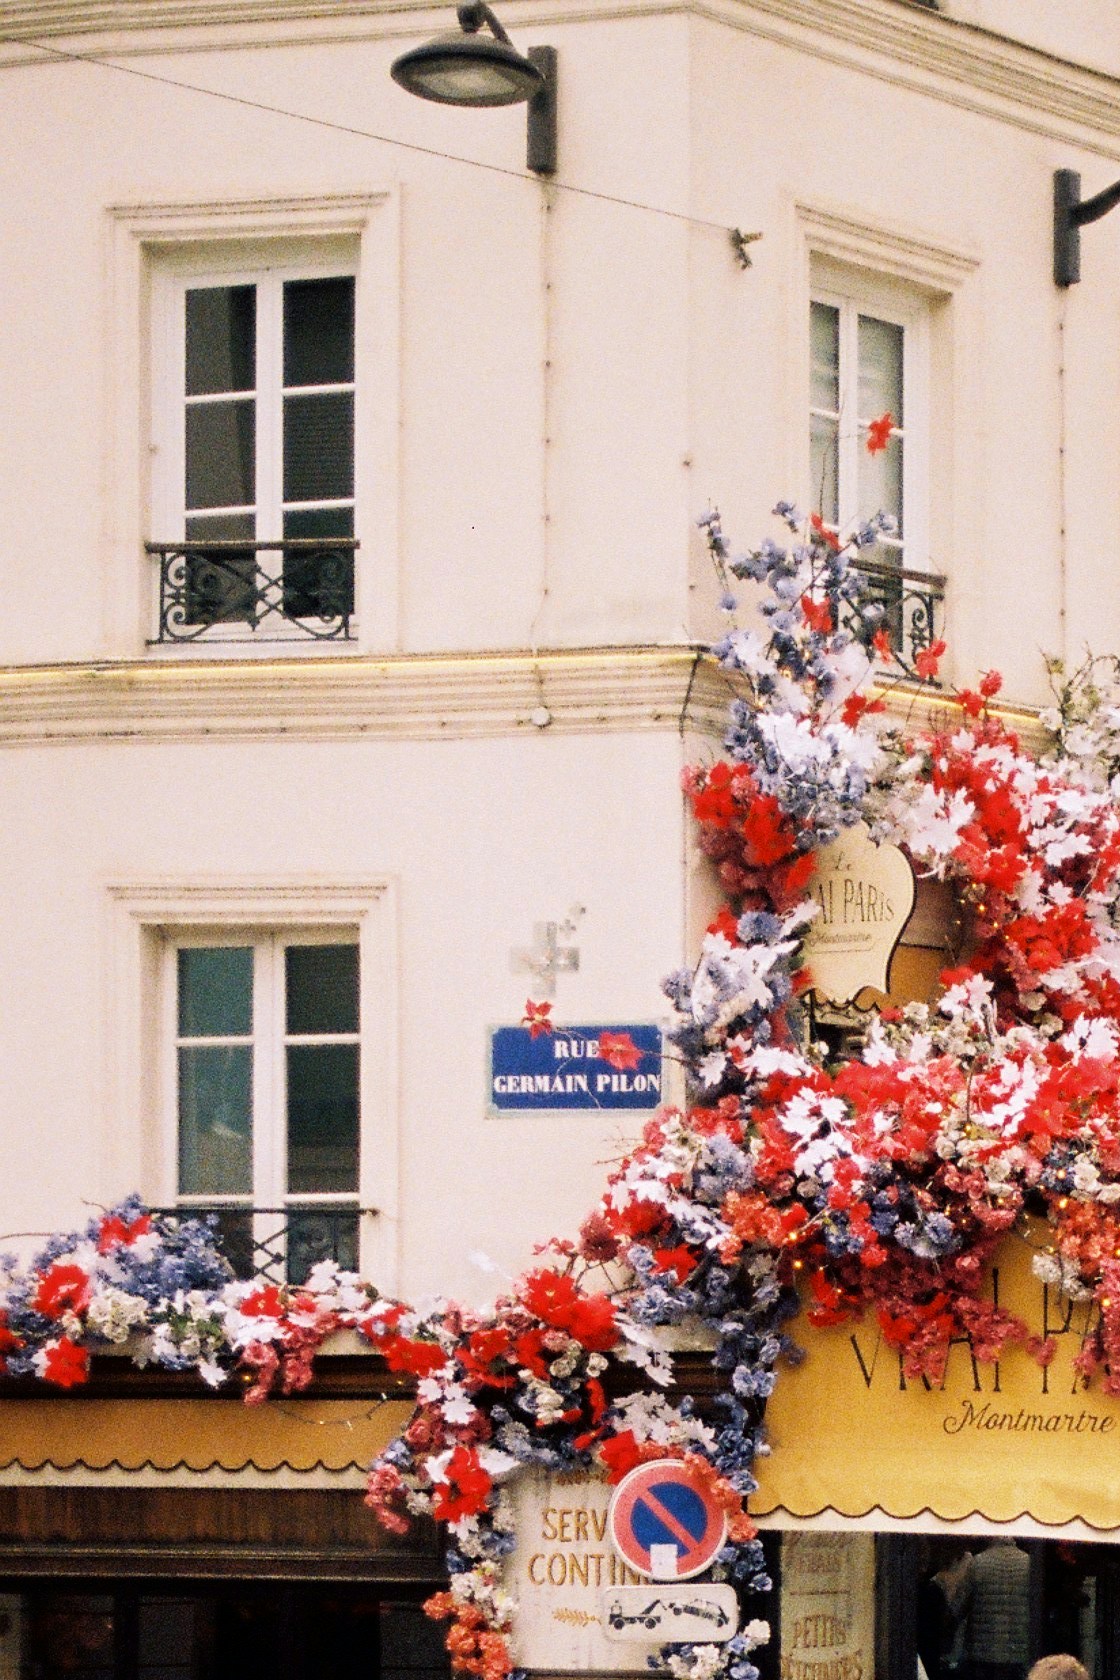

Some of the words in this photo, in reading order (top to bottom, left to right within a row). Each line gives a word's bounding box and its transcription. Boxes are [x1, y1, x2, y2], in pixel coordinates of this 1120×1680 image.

[843, 878, 895, 924] PARIS
[554, 1040, 599, 1058] RUE
[493, 1074, 589, 1094] GERMAIN
[597, 1073, 661, 1092] PILON
[943, 1400, 1116, 1434] Montmartre
[541, 1507, 608, 1543] SERV
[527, 1552, 651, 1586] CONTIN
